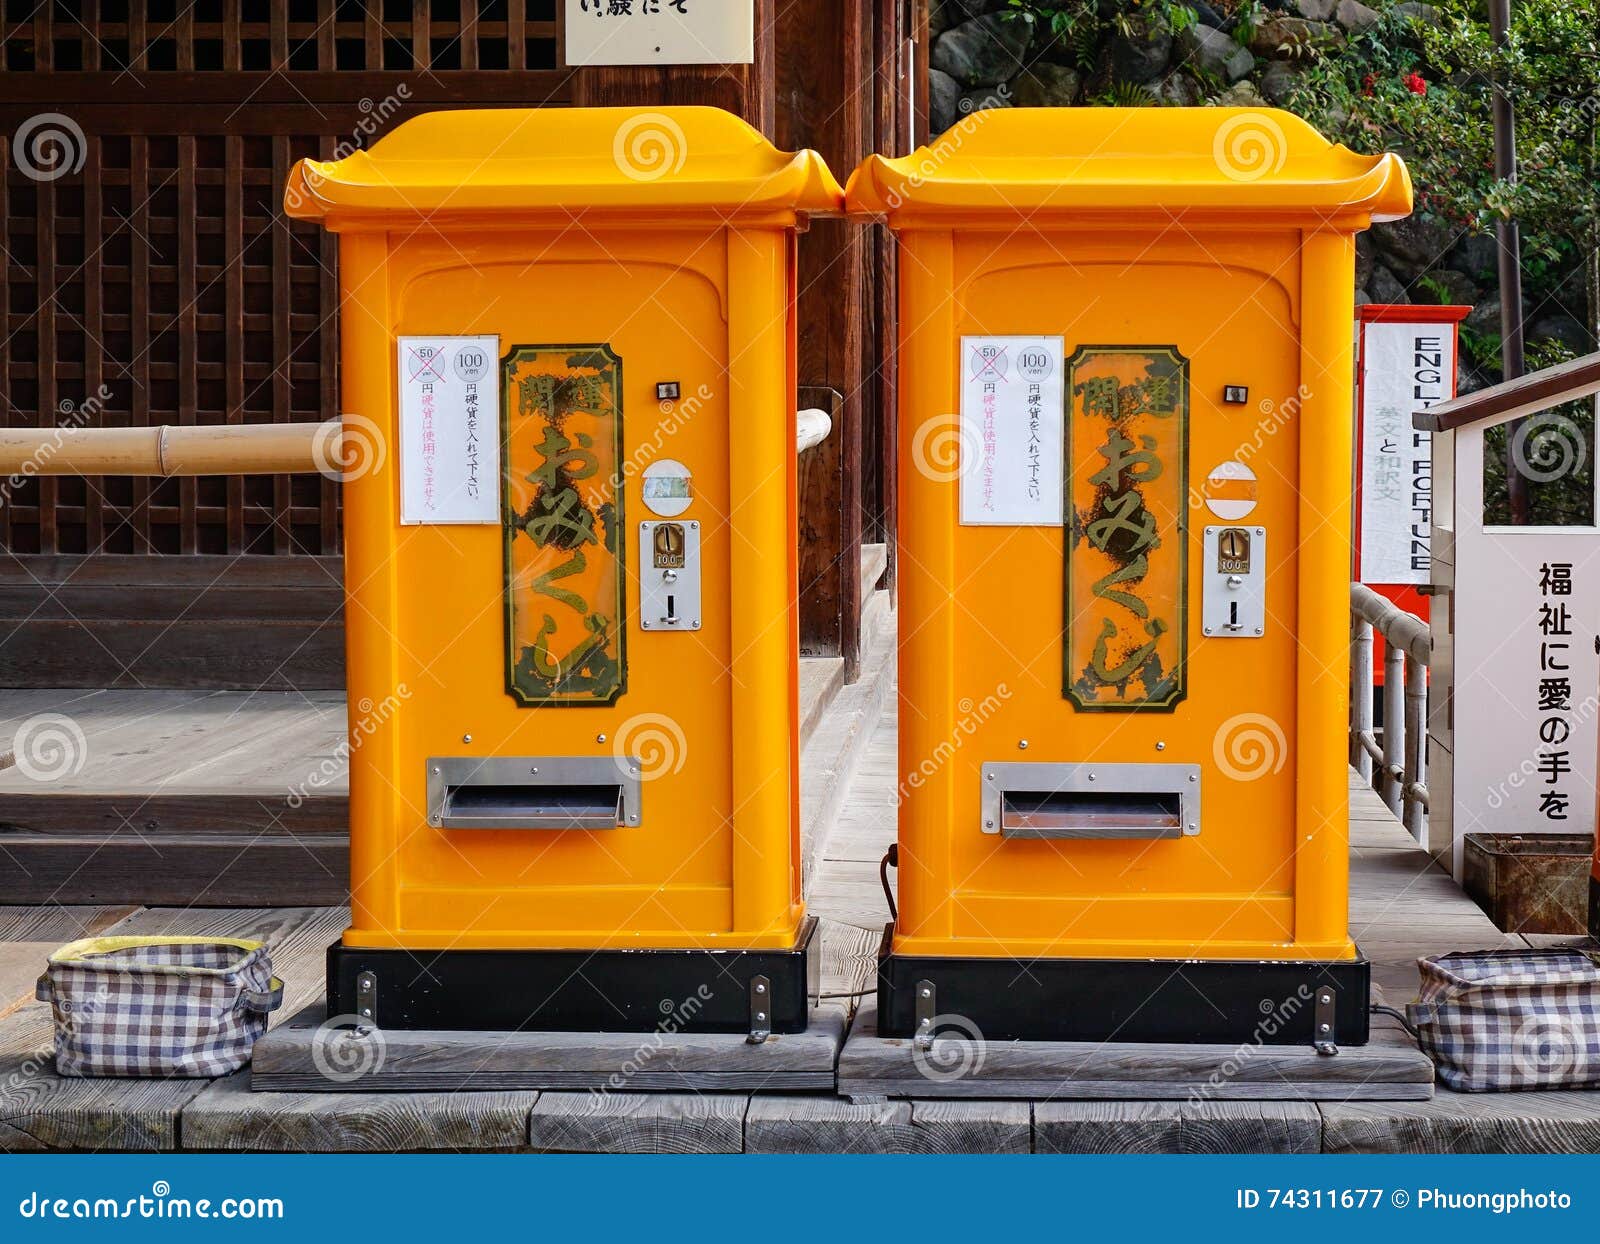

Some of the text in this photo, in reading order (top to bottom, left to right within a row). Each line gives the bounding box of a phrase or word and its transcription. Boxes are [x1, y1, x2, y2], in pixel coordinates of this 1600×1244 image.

[419, 348, 433, 358] 50
[983, 347, 996, 357] 50
[459, 353, 482, 368] 100
[1023, 353, 1047, 368] 100
[464, 368, 479, 376] yen
[526, 426, 611, 677] おみくじ
[1088, 428, 1168, 682] おみくじ
[1538, 563, 1573, 820] 福祉に愛の手を
